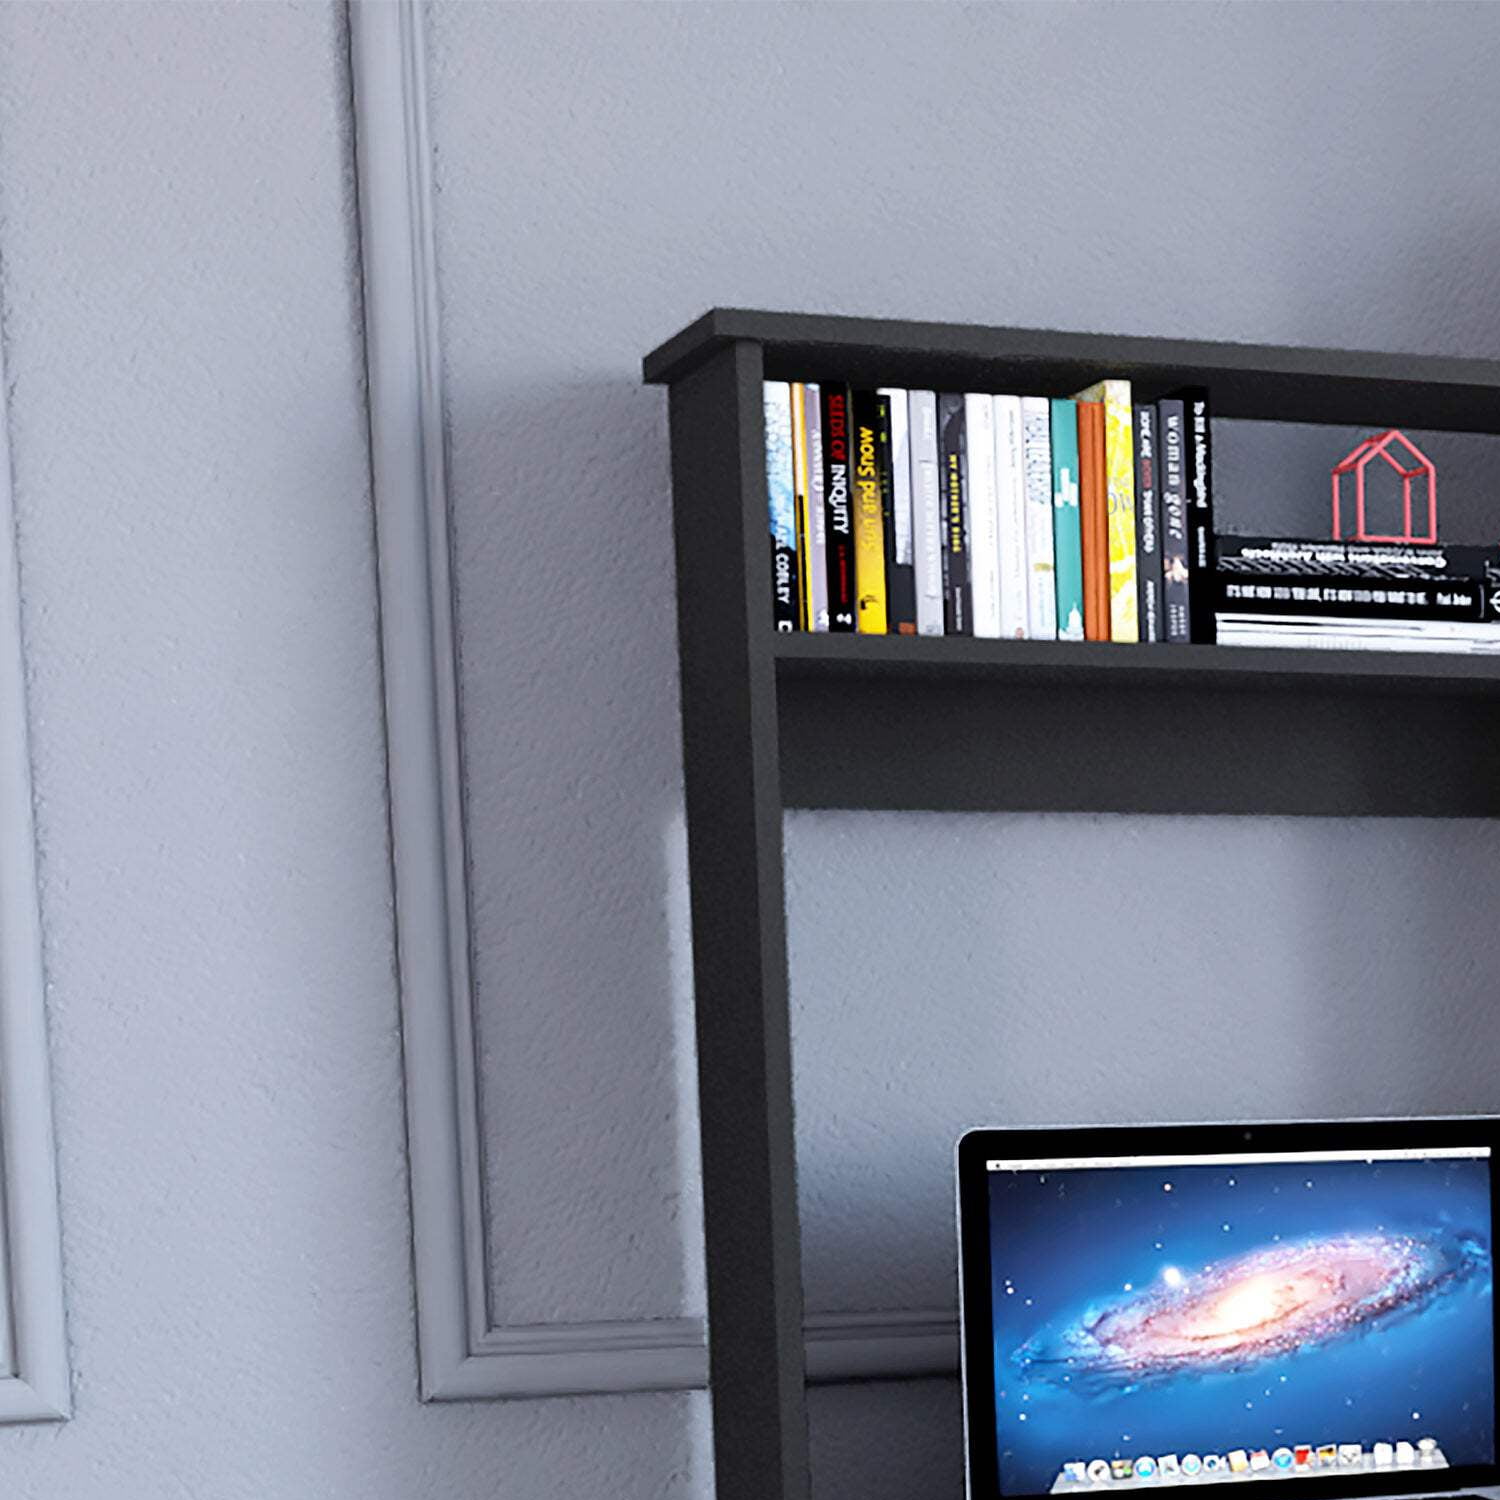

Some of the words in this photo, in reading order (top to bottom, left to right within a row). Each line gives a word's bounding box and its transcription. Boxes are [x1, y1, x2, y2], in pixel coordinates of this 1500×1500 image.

[828, 394, 846, 438] SEEDS
[829, 439, 846, 461] OF
[857, 426, 876, 476] Snow
[1166, 415, 1182, 486] woman
[828, 463, 849, 534] INIQUITY
[857, 481, 876, 516] and
[1165, 491, 1184, 540] gone
[860, 518, 877, 552] Sun
